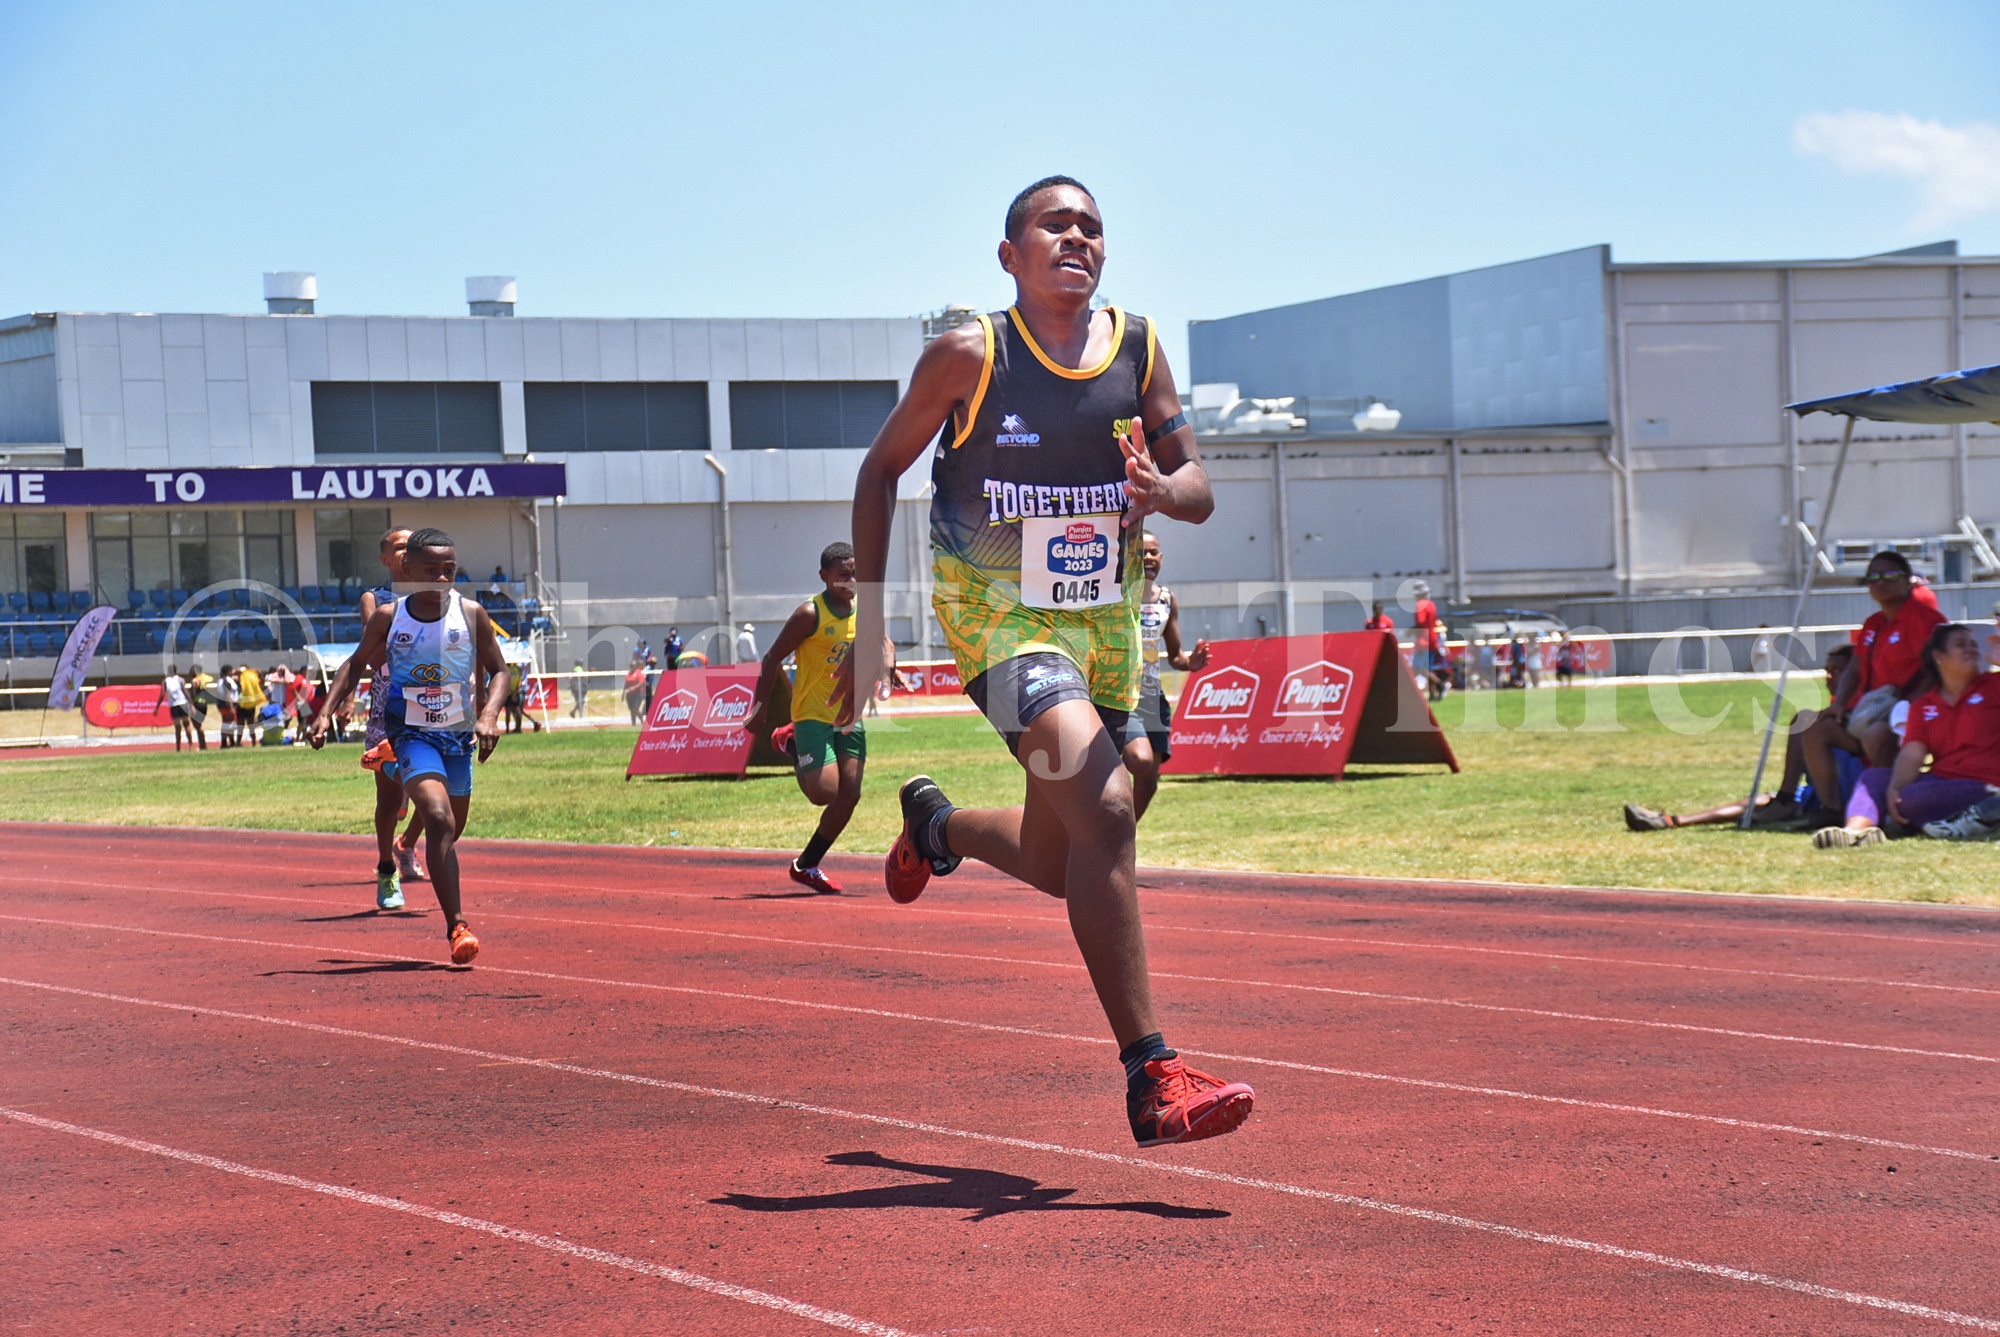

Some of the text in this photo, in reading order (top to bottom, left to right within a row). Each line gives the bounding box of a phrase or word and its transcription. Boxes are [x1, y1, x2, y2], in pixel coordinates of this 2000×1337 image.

[996, 433, 1040, 444] BEYOND
[146, 472, 205, 502] TO
[291, 467, 494, 500] LAUTOKA
[1068, 526, 1092, 534] Punjas
[1051, 542, 1105, 559] GAMES
[1064, 559, 1093, 572] 2023
[1052, 579, 1101, 604] 0445
[71, 616, 99, 669] PACIFIC
[419, 694, 451, 705] GAMES
[1194, 681, 1251, 713] Punjas
[1283, 677, 1345, 710] Punjas
[657, 700, 692, 725] Punjas
[710, 696, 748, 721] Punjas
[425, 711, 448, 723] 1691
[693, 737, 708, 748] Choice
[1171, 731, 1193, 745] Choice
[1194, 731, 1203, 743] of
[1203, 732, 1216, 744] the
[1259, 730, 1284, 744] Choice
[1285, 730, 1294, 743] of
[1294, 730, 1307, 742] the
[640, 740, 654, 751] Choice
